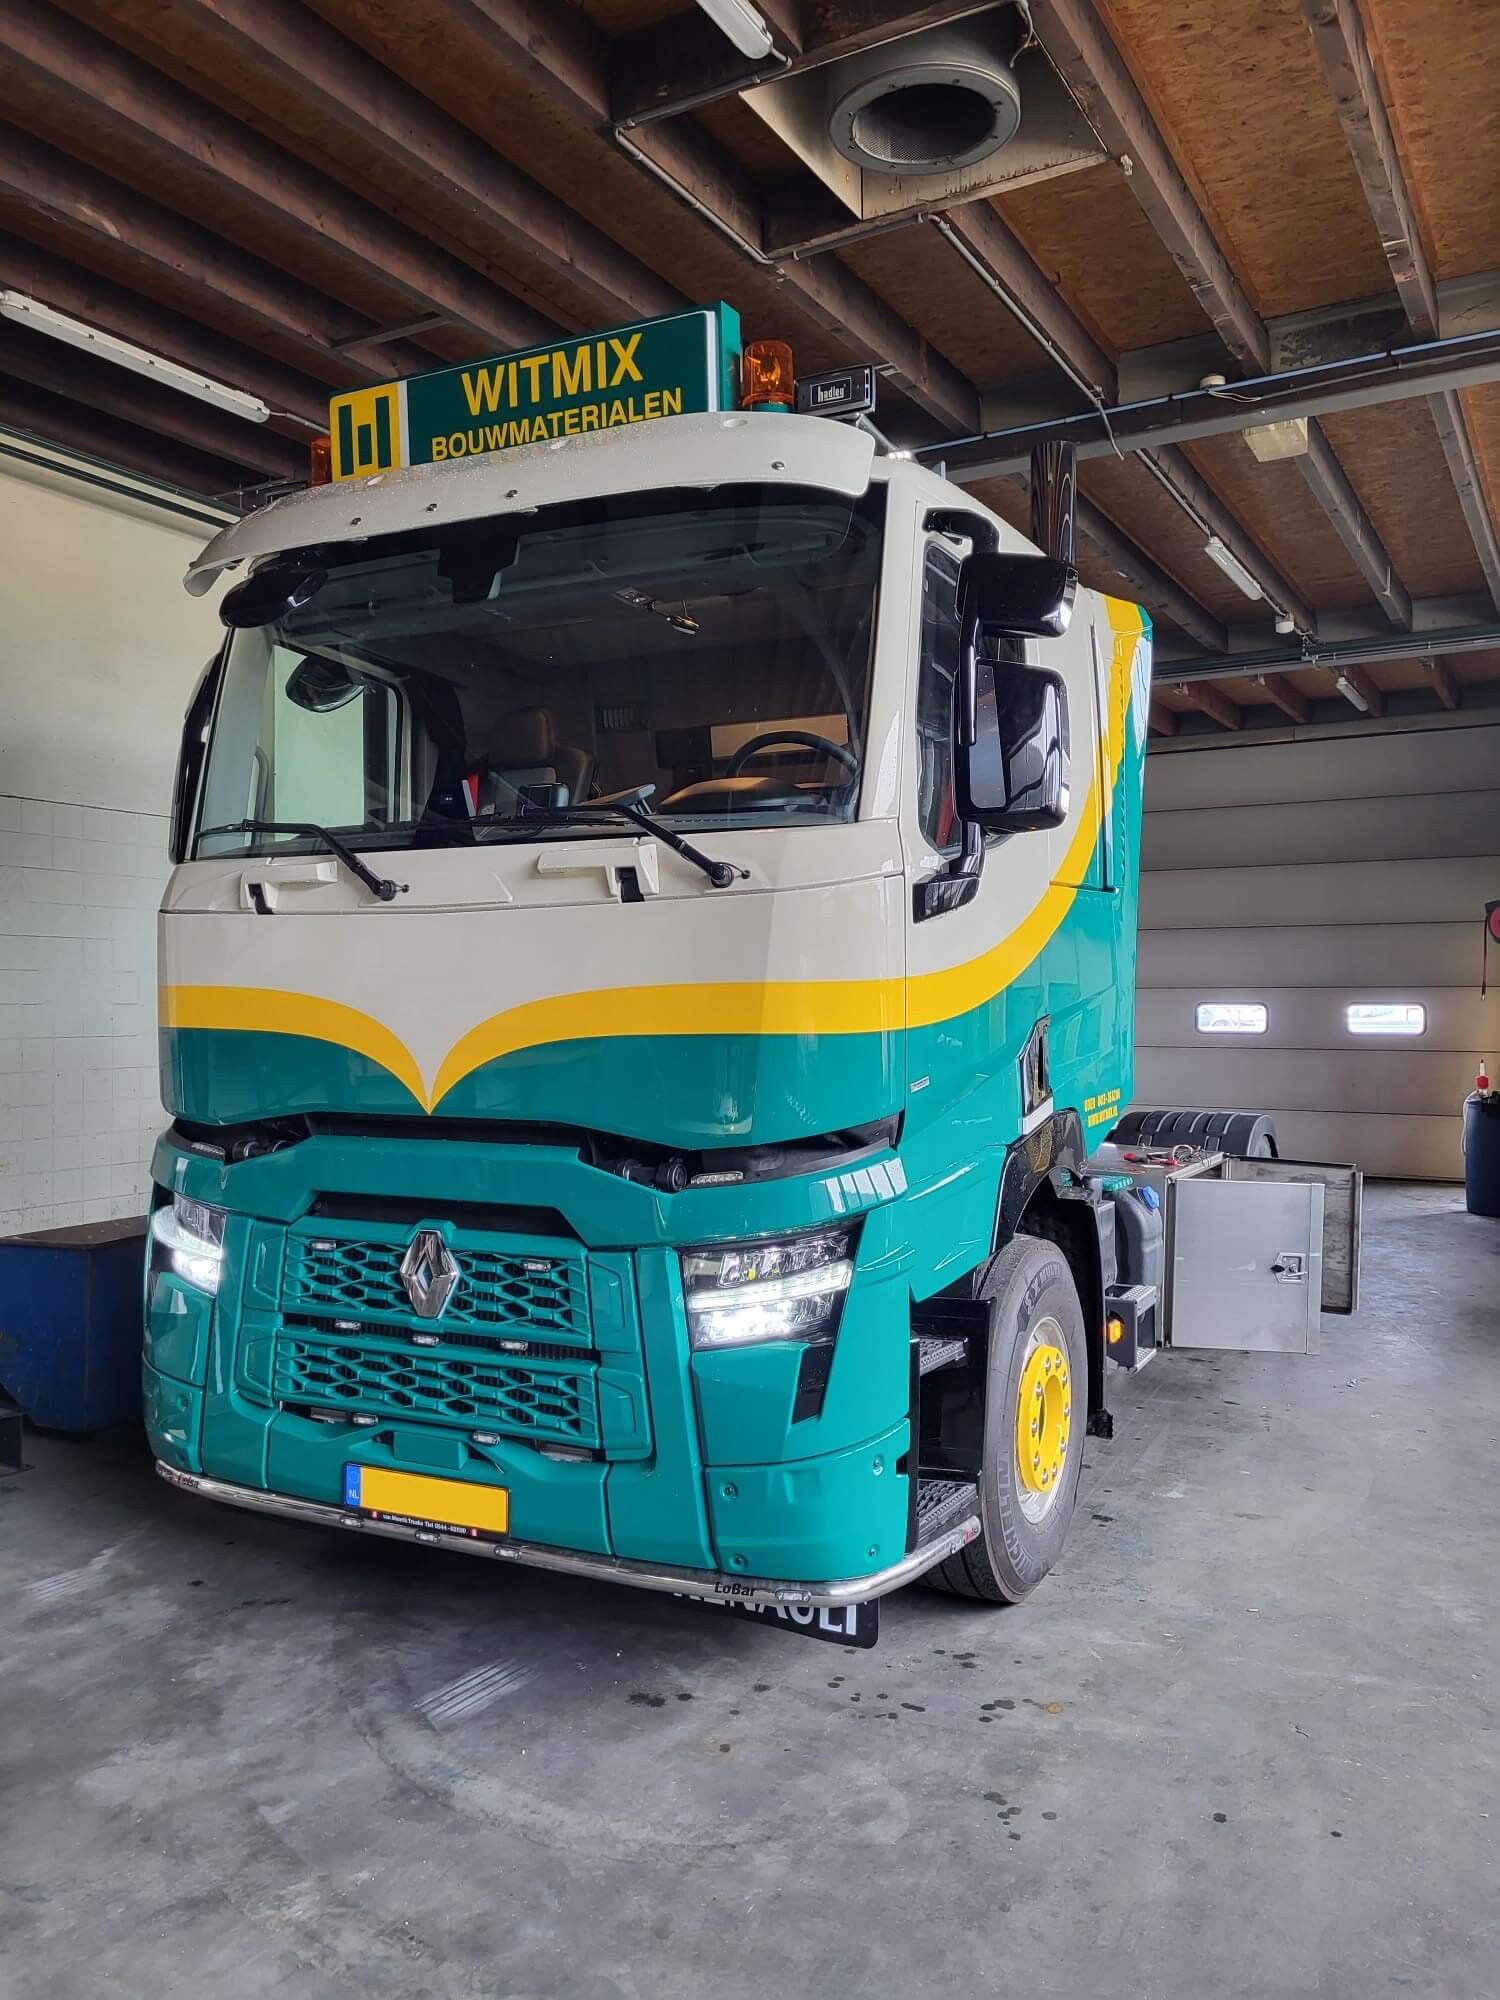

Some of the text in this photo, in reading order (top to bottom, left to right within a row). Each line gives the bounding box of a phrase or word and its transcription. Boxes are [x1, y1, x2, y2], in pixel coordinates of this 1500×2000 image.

[461, 332, 644, 417] WITMIX
[817, 383, 846, 403] hadley
[431, 386, 683, 462] BOUWMATERIALEN
[349, 1489, 359, 1499] NL
[714, 1581, 756, 1597] LoBar
